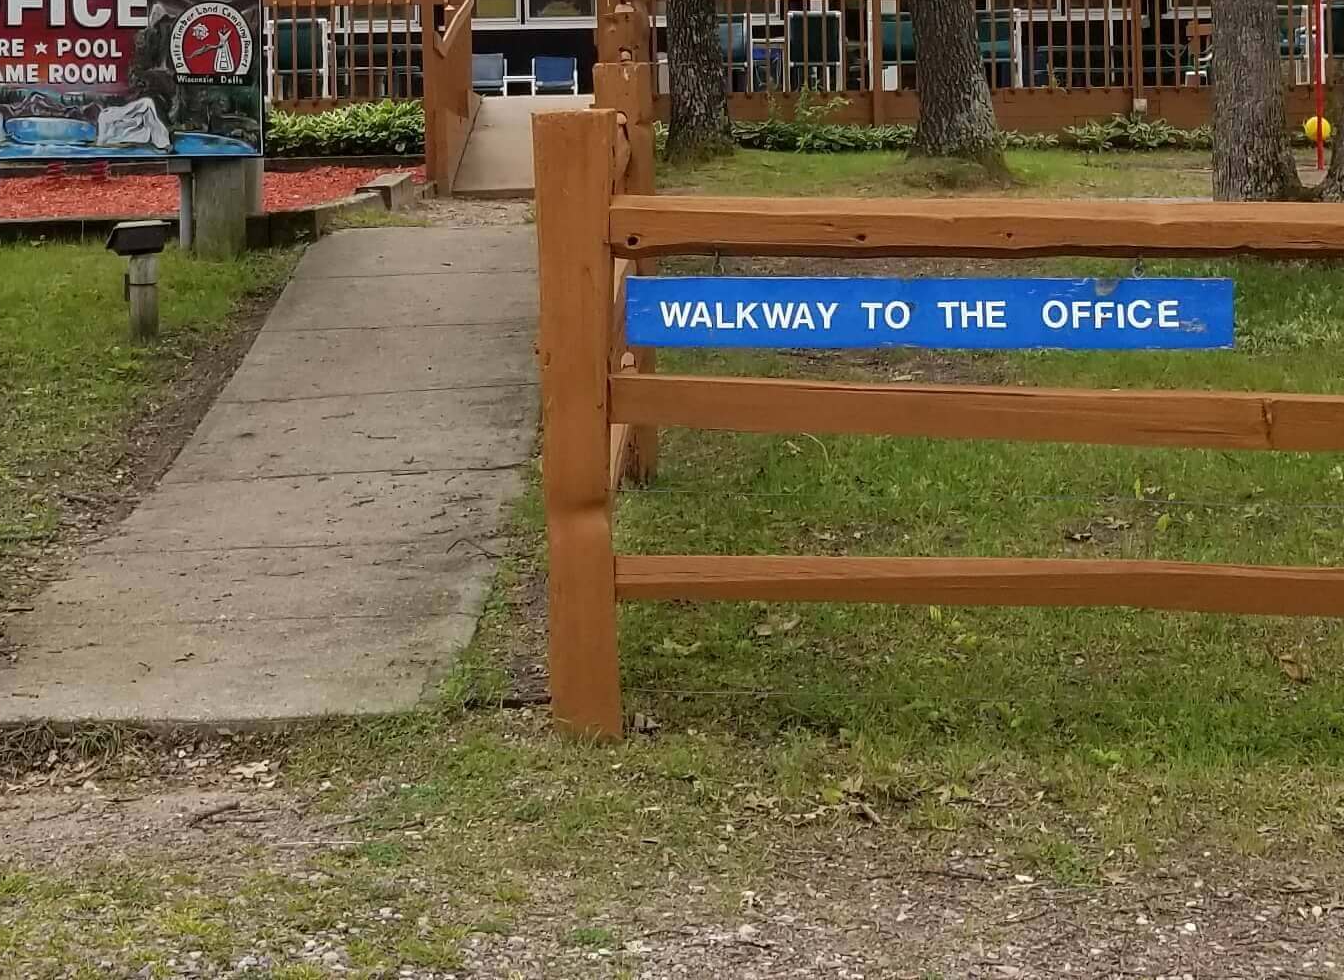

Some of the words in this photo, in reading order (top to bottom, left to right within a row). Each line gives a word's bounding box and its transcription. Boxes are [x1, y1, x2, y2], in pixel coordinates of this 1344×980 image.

[196, 6, 218, 15] Land
[57, 38, 123, 58] POOL
[48, 63, 117, 83] ROOM
[659, 301, 838, 330] WALKWAY
[861, 300, 911, 330] TO
[937, 300, 1007, 329] THE
[1042, 299, 1180, 330] OFFICE
